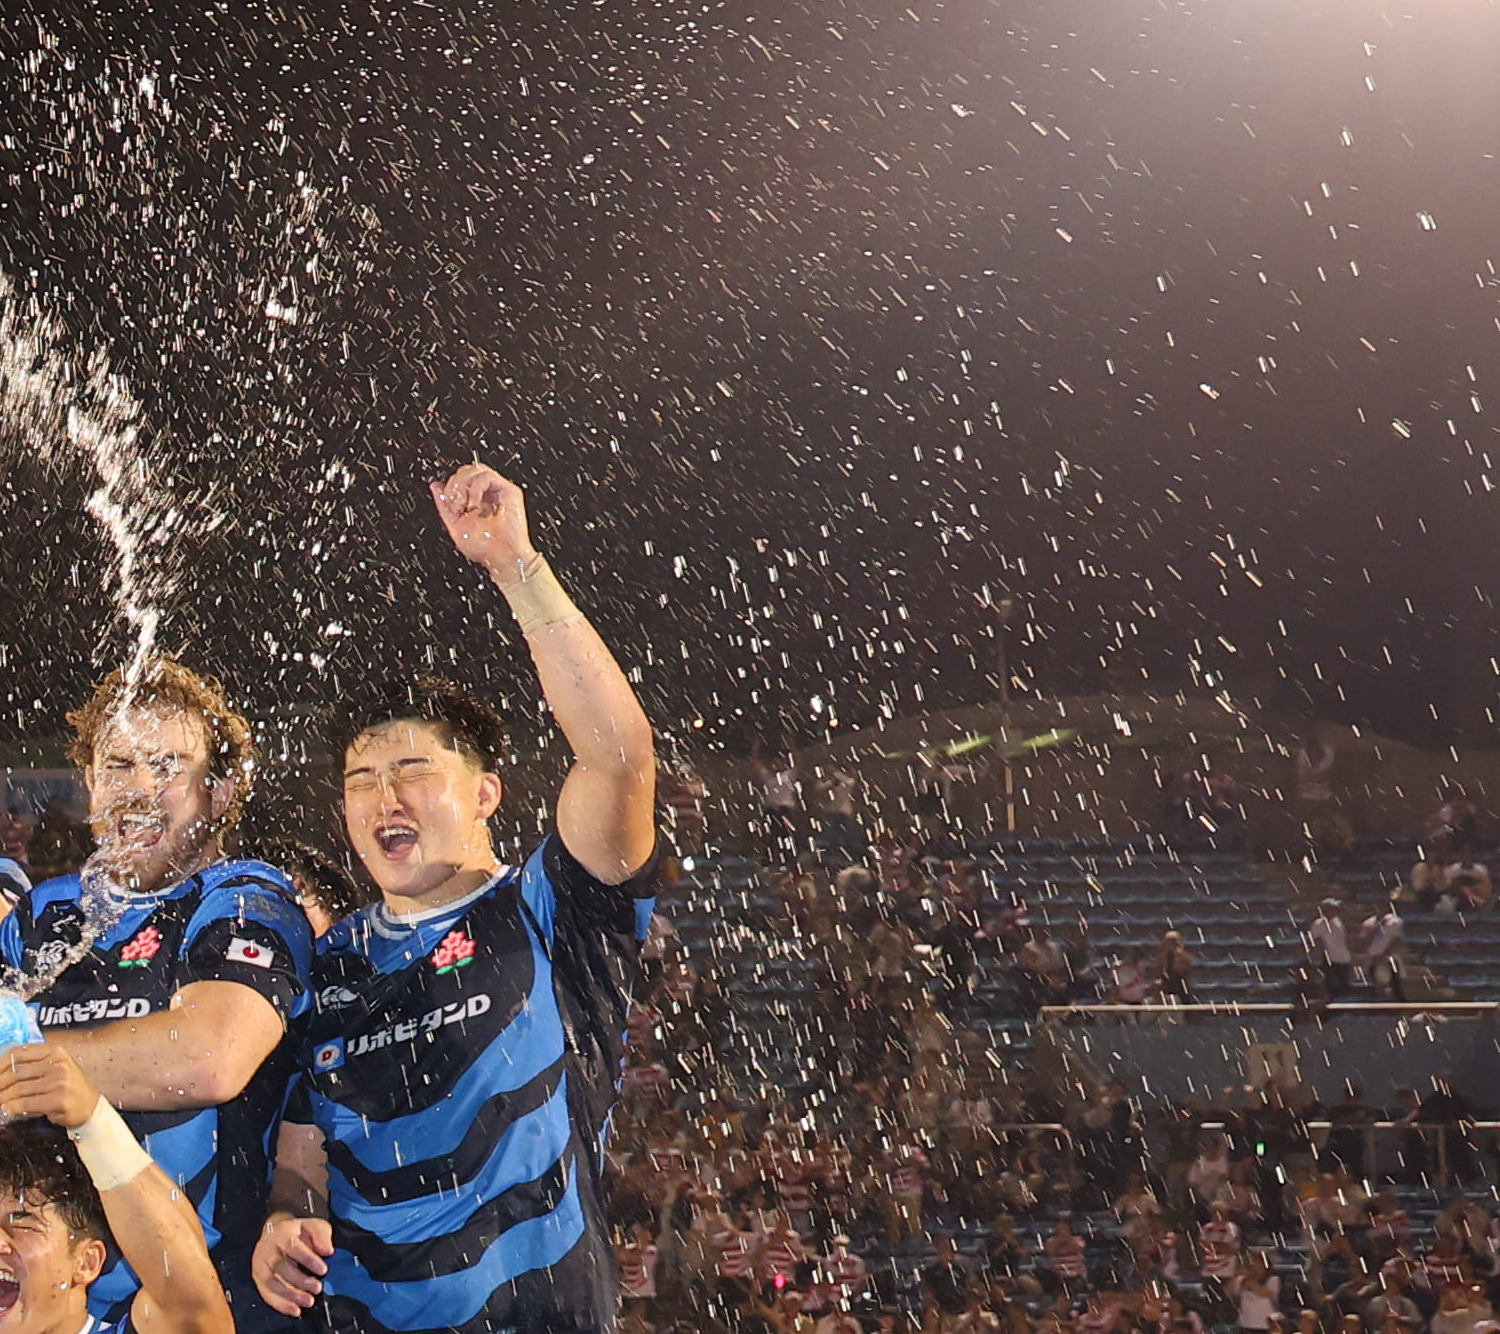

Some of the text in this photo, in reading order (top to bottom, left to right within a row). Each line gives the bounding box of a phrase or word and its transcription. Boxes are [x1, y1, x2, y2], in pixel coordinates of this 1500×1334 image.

[40, 998, 150, 1027] リポビタンD
[347, 994, 492, 1057] リポビタンD
